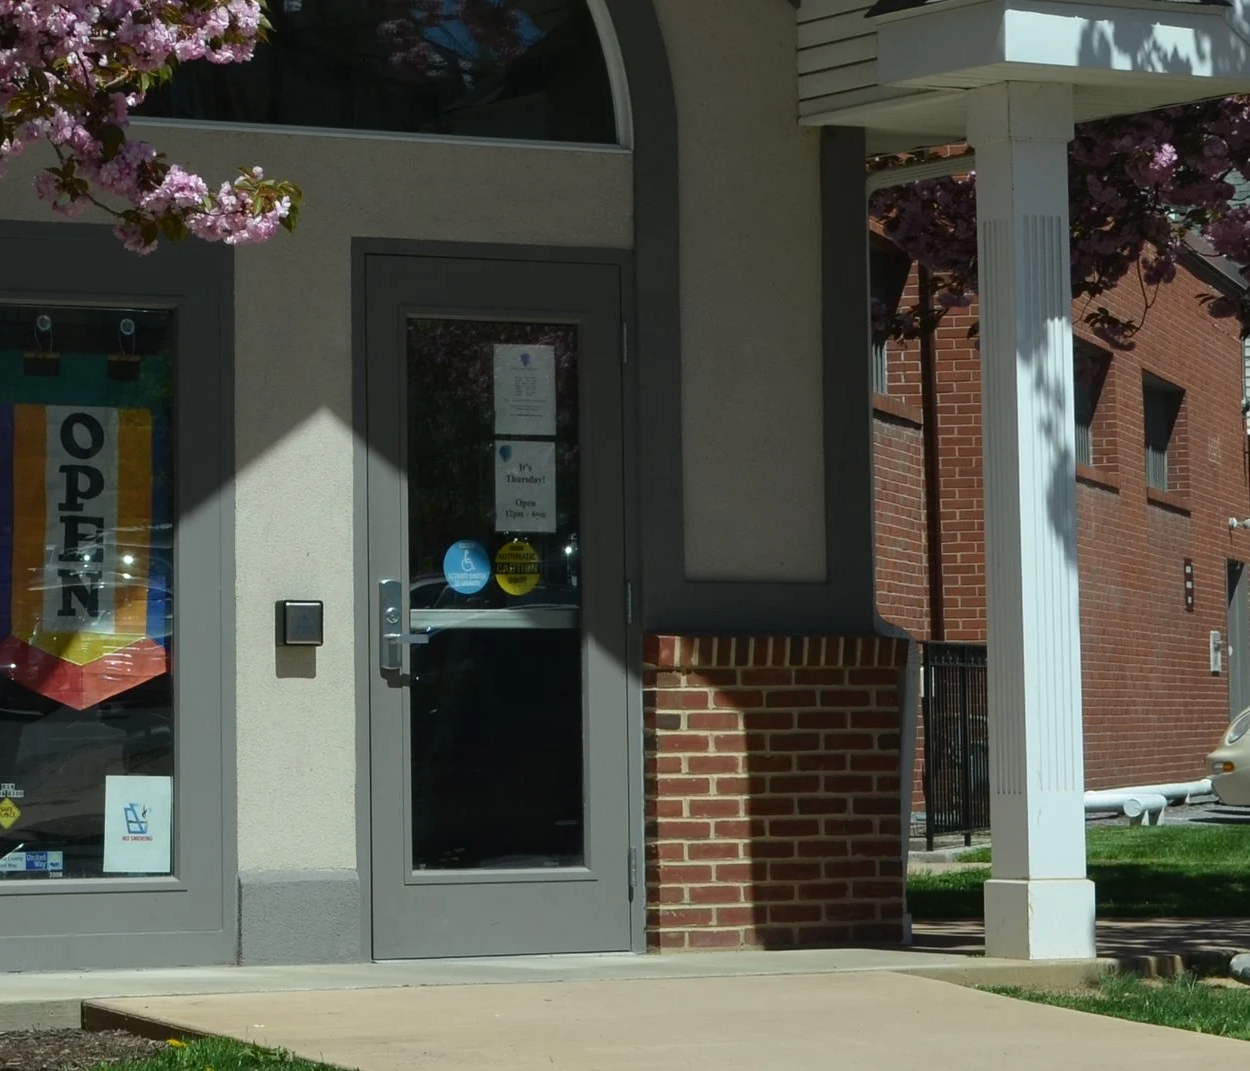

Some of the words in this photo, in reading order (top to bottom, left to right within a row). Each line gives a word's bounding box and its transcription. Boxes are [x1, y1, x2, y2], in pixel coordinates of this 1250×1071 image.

[519, 463, 532, 472] It's
[506, 475, 546, 486] Thursday!
[515, 499, 536, 509] Open
[57, 412, 105, 618] OPEN
[496, 563, 539, 573] CAUTION
[26, 854, 47, 862] United
